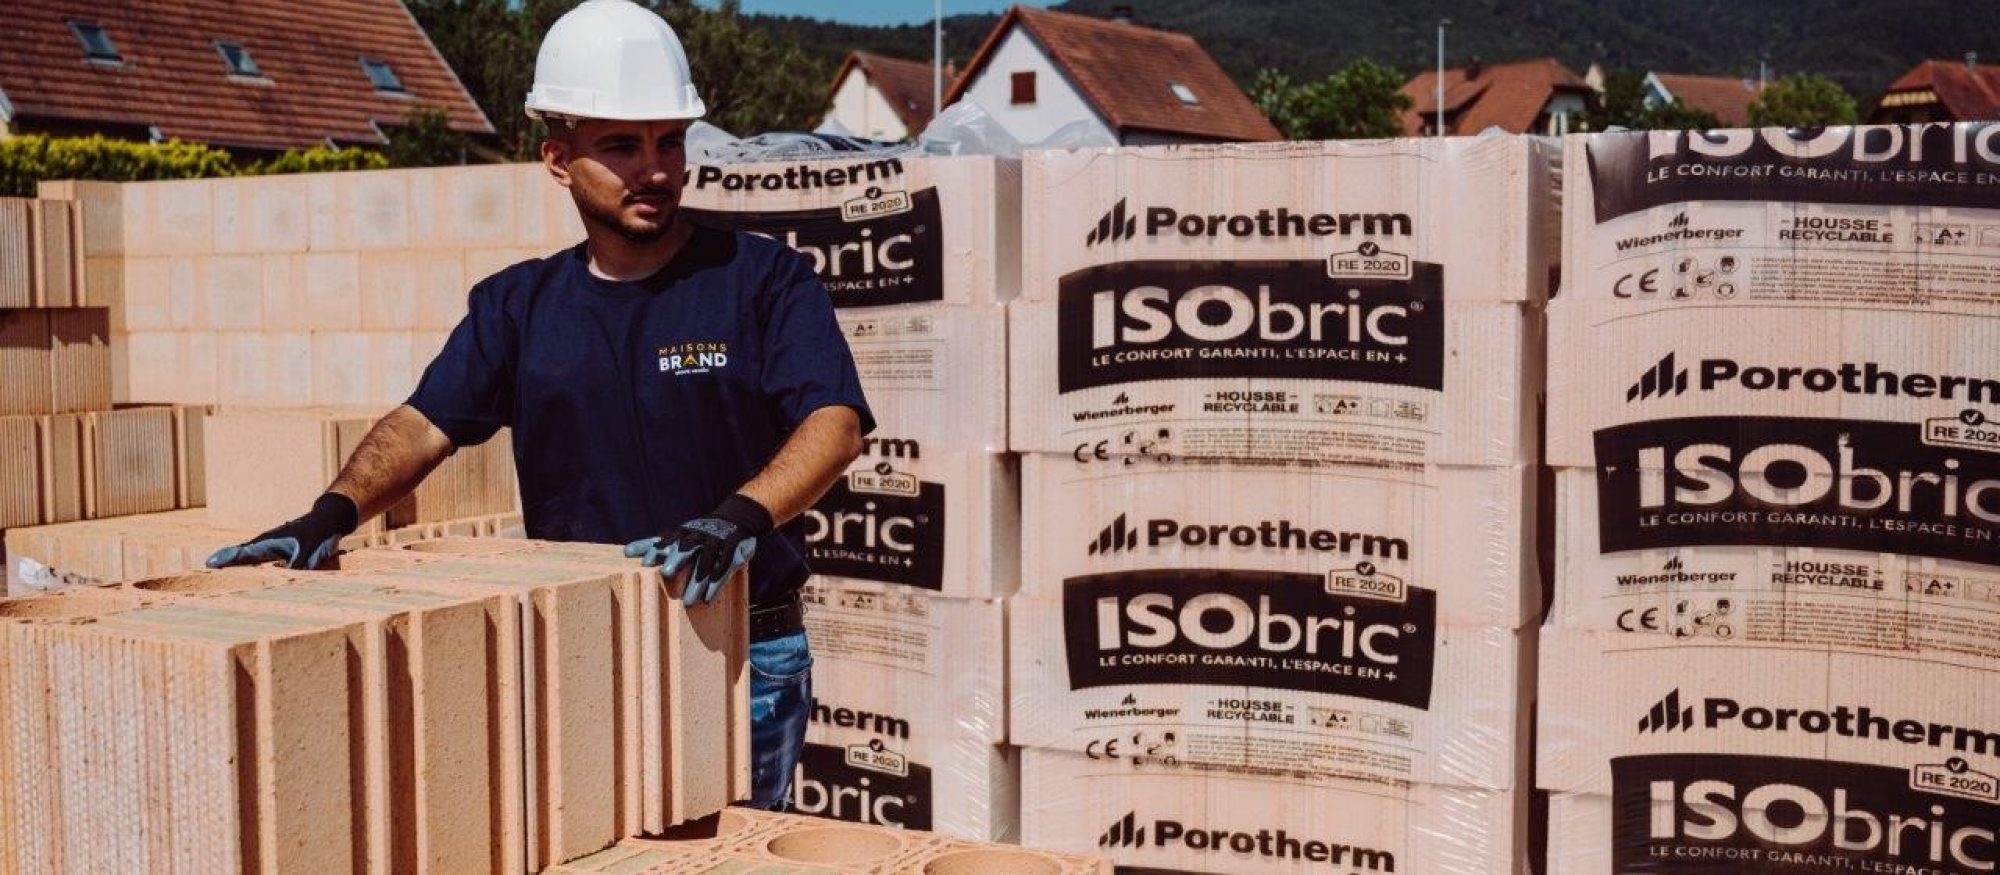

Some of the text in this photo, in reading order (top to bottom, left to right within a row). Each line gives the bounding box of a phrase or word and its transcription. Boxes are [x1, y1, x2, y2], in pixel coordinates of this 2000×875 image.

[697, 158, 904, 191] Porotherm
[1647, 167, 1670, 183] LE
[1677, 164, 1772, 178] CONFORT
[1881, 171, 1968, 184] L'ESPACE
[851, 199, 902, 215] RE 2020
[1146, 207, 1411, 237] Porotherm
[1794, 217, 1879, 231] HOUSSE
[1616, 228, 1744, 250] Wienerberger
[1779, 230, 1894, 243] RECYCLABLE
[1338, 259, 1401, 272] RE 2020
[879, 277, 899, 288] EN
[659, 343, 727, 356] MAISONS
[1093, 354, 1110, 366] LE
[1115, 347, 1195, 362] CONFORT
[1199, 347, 1280, 361] GARANTI,
[1286, 349, 1360, 361] L'ESPACE
[1366, 352, 1390, 363] EN
[659, 353, 728, 372] BRAND
[1216, 391, 1287, 401] HOUSSE
[1073, 403, 1175, 422] Wienerberger
[1204, 402, 1299, 413] RECYCLABLE
[1934, 426, 2000, 443] RE 202
[1640, 511, 1991, 540] LE CONFORT GARANTI, L'ESPACE EN
[1148, 519, 1409, 560] Porotherm
[880, 555, 899, 565] EN
[1787, 561, 1869, 576] HOUSSE
[1335, 576, 1396, 594] RE 2020
[1617, 572, 1738, 586] Wienerberger
[1772, 573, 1884, 590] RECYCLABLE
[1100, 655, 1117, 667] LE
[1122, 654, 1196, 666] CONFORT
[1202, 654, 1278, 669] GARANTI,
[1282, 658, 1352, 677] L'ESPACE
[1358, 666, 1381, 679] EN
[1218, 698, 1283, 711] HOUSSE
[1084, 707, 1180, 720] Wienerberger
[1207, 709, 1295, 724] RECYCLABLE
[1704, 697, 2000, 757] Porotherm
[852, 752, 900, 768] RE 2020
[1921, 771, 1991, 793] RE 2020
[1154, 820, 1395, 873] Porotherm
[1651, 846, 1670, 856] LE
[1675, 846, 1760, 860] CONFORT
